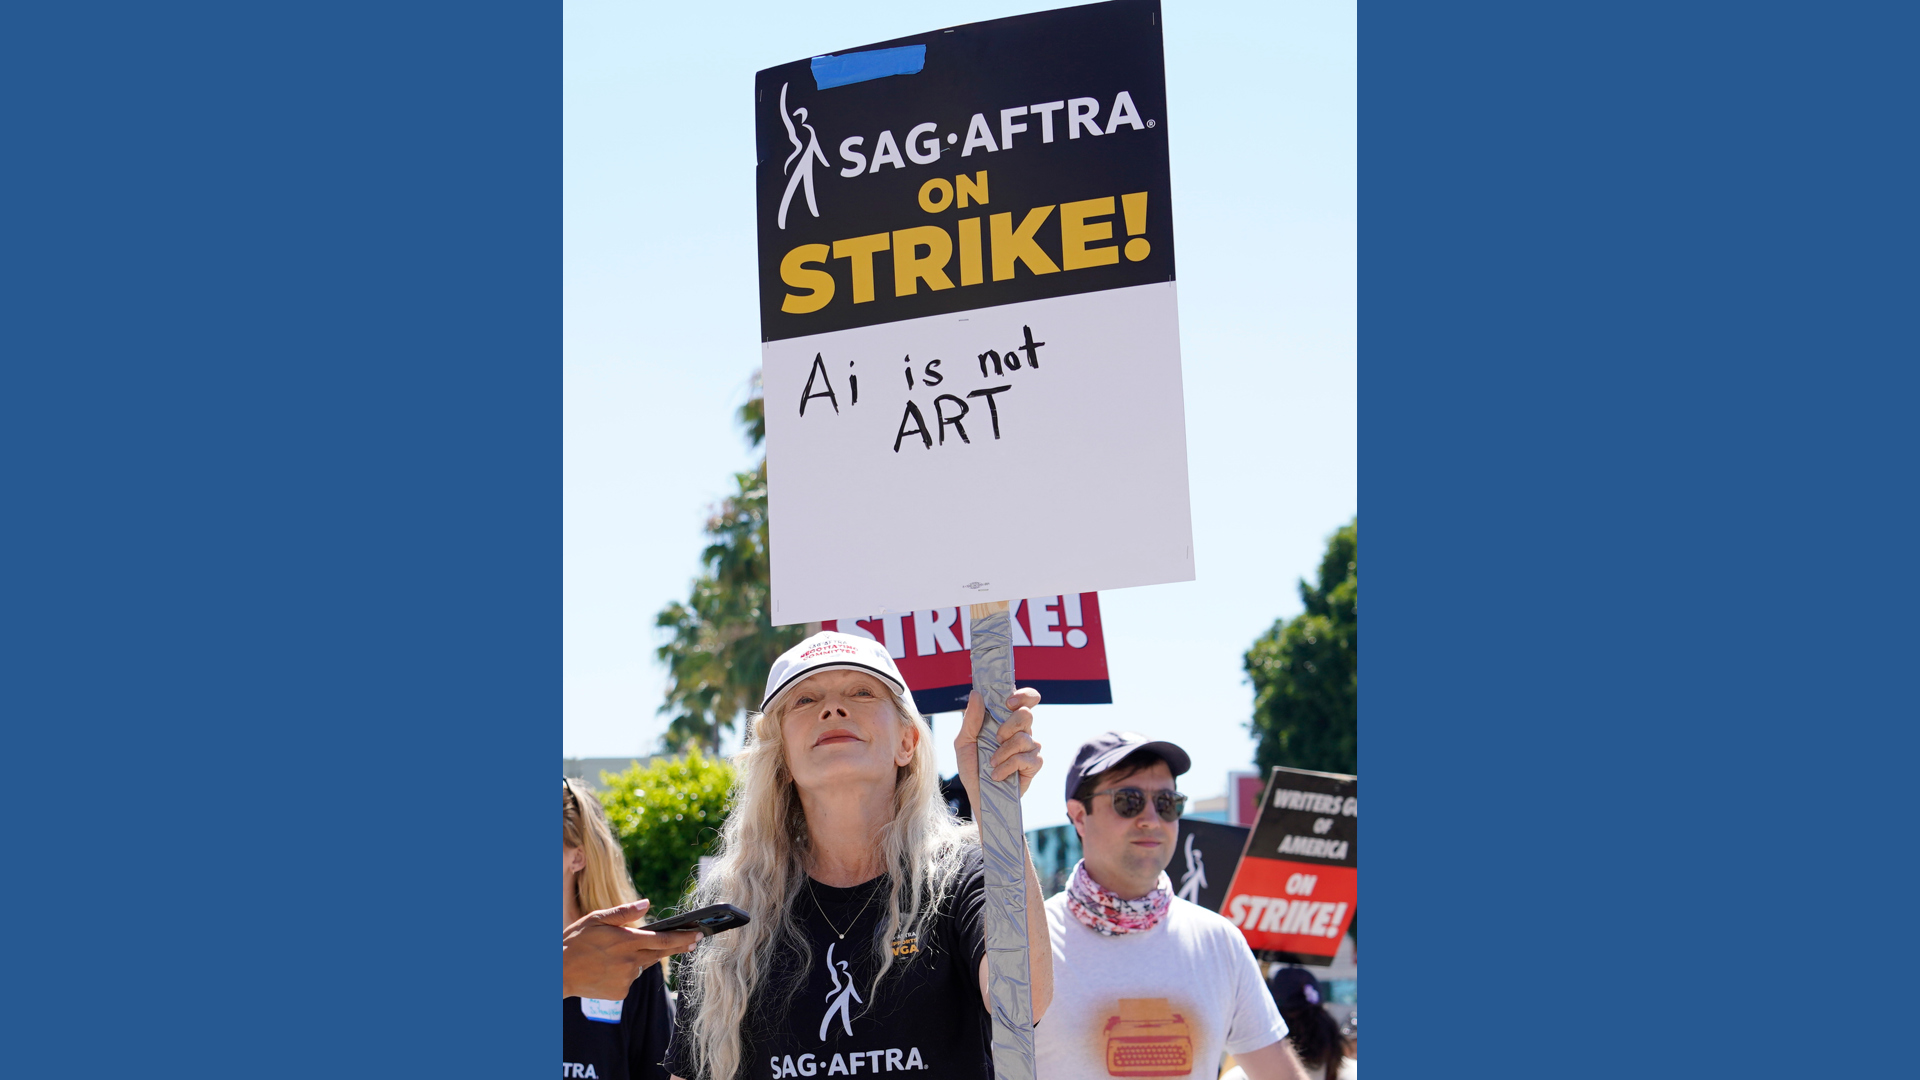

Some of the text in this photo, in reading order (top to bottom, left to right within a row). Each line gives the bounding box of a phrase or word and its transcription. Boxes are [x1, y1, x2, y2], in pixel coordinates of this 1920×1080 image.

[918, 170, 989, 213] ON
[779, 191, 1151, 314] STRIKE!
[800, 325, 1045, 417] Ai is not
[894, 384, 1012, 453] ART
[1273, 788, 1343, 815] WRITERS
[1277, 834, 1349, 860] AMERICA
[1312, 817, 1334, 835] OF
[1285, 873, 1318, 896] ON
[1228, 894, 1348, 938] STRIKE!
